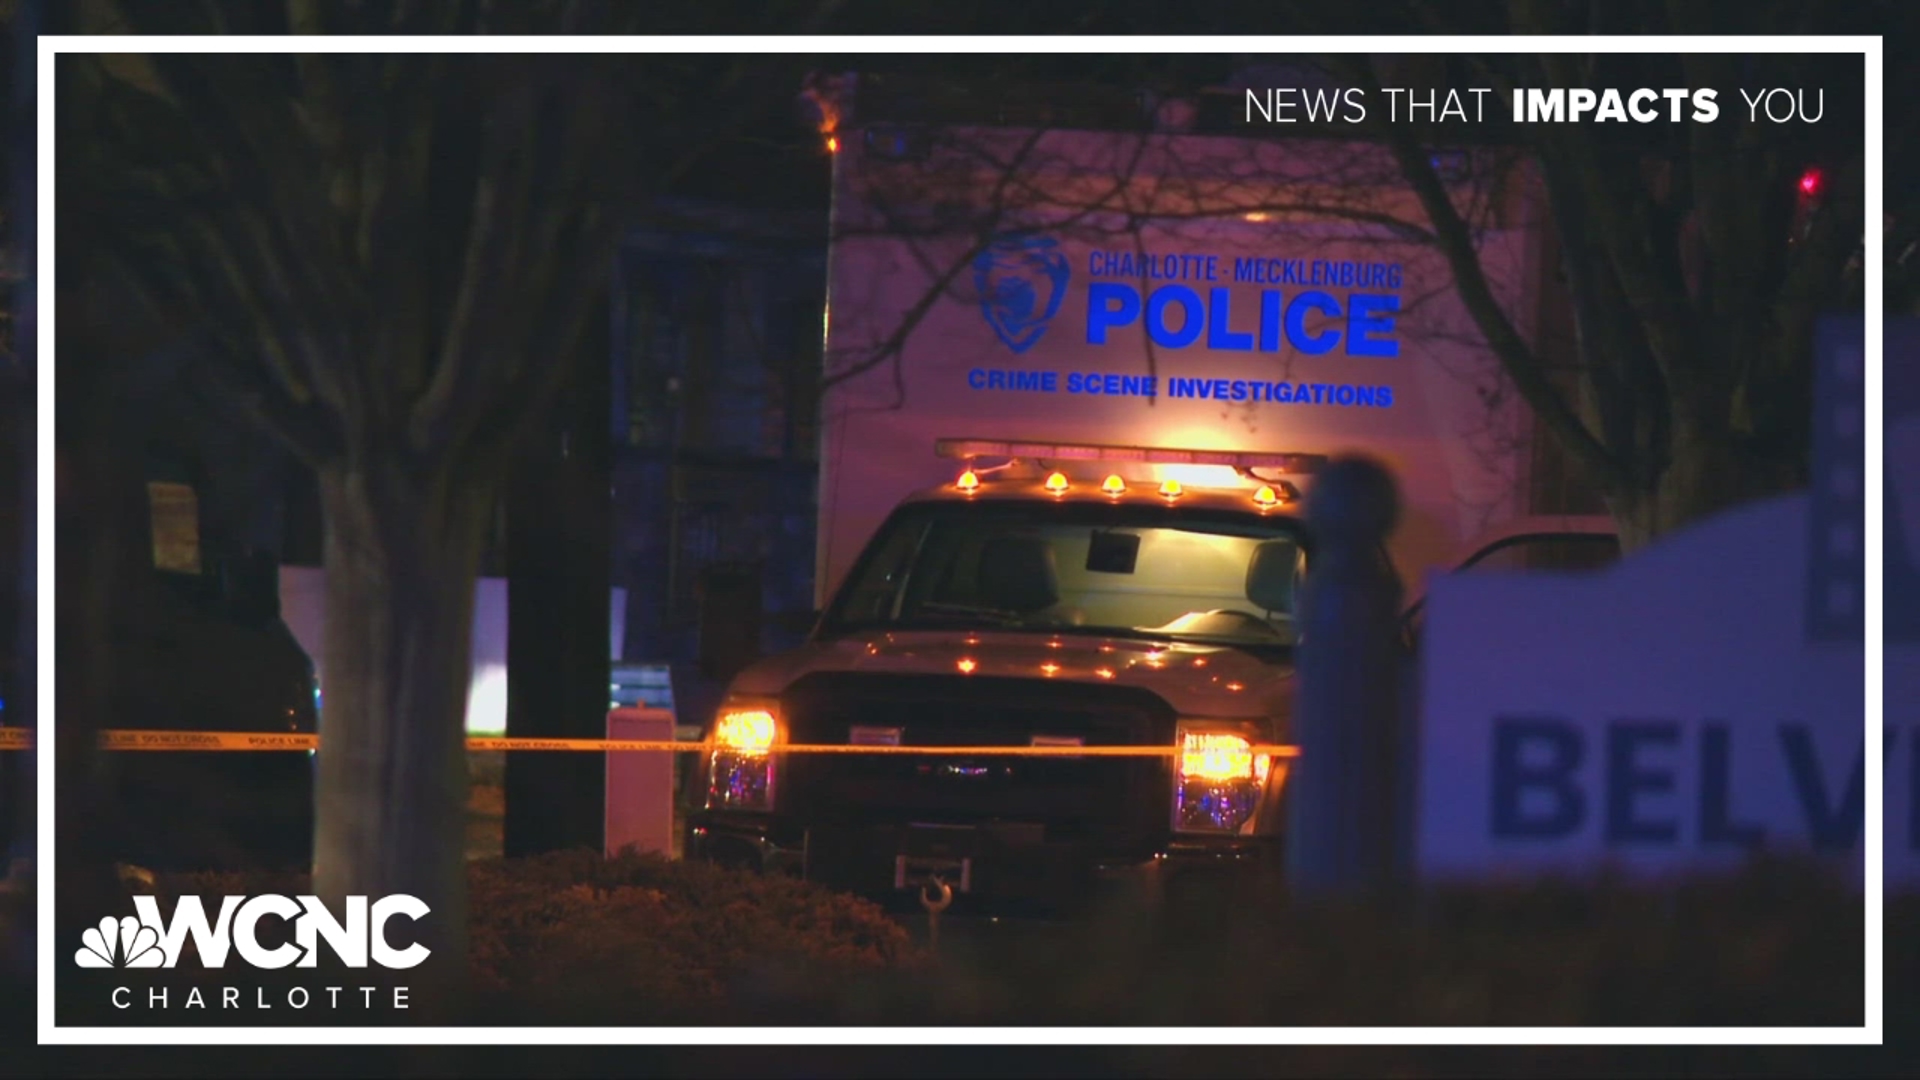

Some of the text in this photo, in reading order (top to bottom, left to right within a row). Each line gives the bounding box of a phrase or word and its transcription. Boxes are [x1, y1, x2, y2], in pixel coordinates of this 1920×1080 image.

[1089, 251, 1219, 281] CHARLOTTE
[1234, 257, 1403, 289] MECKLENBURG
[1086, 281, 1401, 358] POLICE
[968, 368, 1394, 408] CRIME SCENE INVESTIGATIONS
[1489, 715, 1920, 851] BELV
